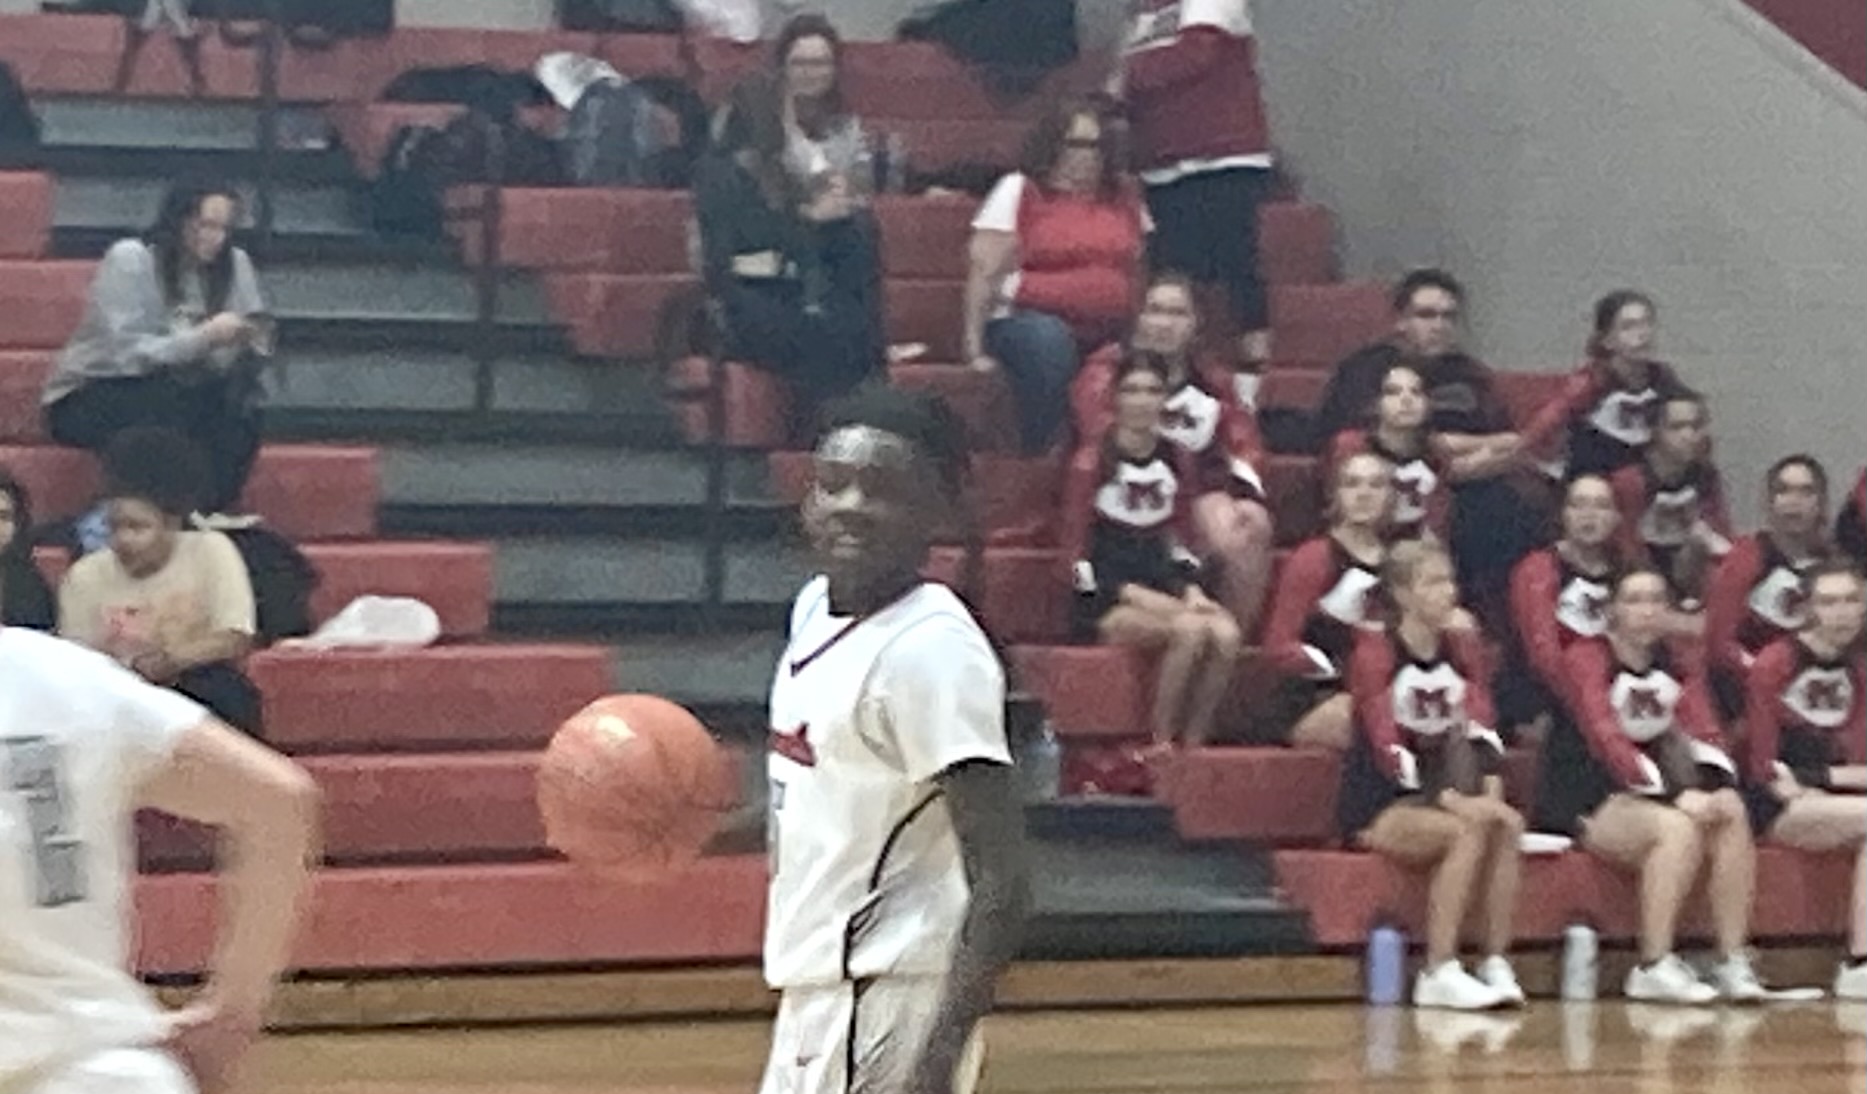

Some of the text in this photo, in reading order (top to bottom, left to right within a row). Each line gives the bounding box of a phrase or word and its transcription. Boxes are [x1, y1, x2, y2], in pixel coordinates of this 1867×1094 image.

[1125, 481, 1168, 510] M
[1412, 686, 1453, 718] M
[1630, 689, 1665, 719] M
[1808, 681, 1846, 710] M
